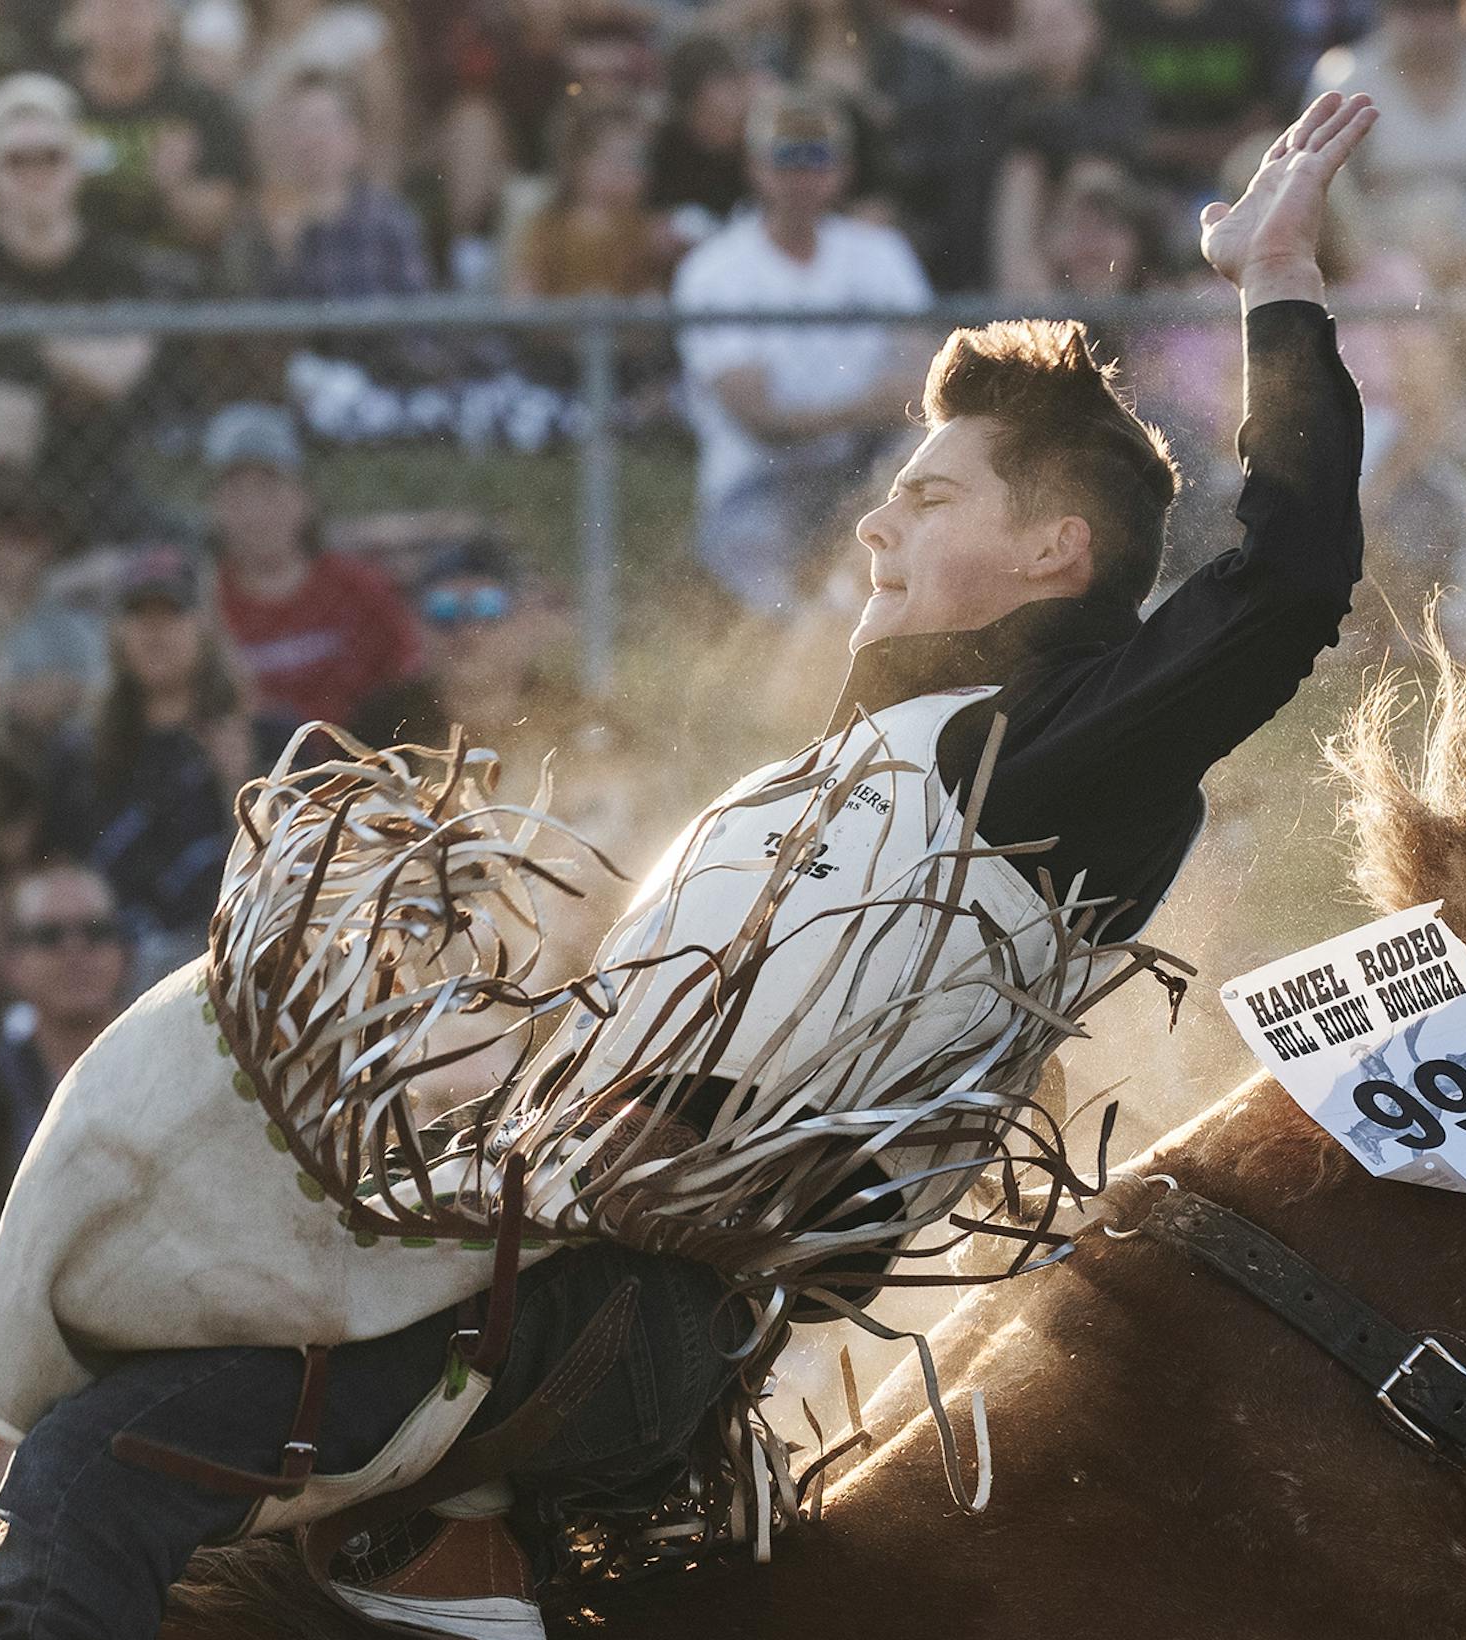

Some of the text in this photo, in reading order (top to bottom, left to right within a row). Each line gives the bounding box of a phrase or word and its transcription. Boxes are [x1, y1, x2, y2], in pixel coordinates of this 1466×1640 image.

[1246, 922, 1448, 1028] HAMEL RODEO
[1263, 960, 1466, 1061] BULL RIDIN' BONANZA
